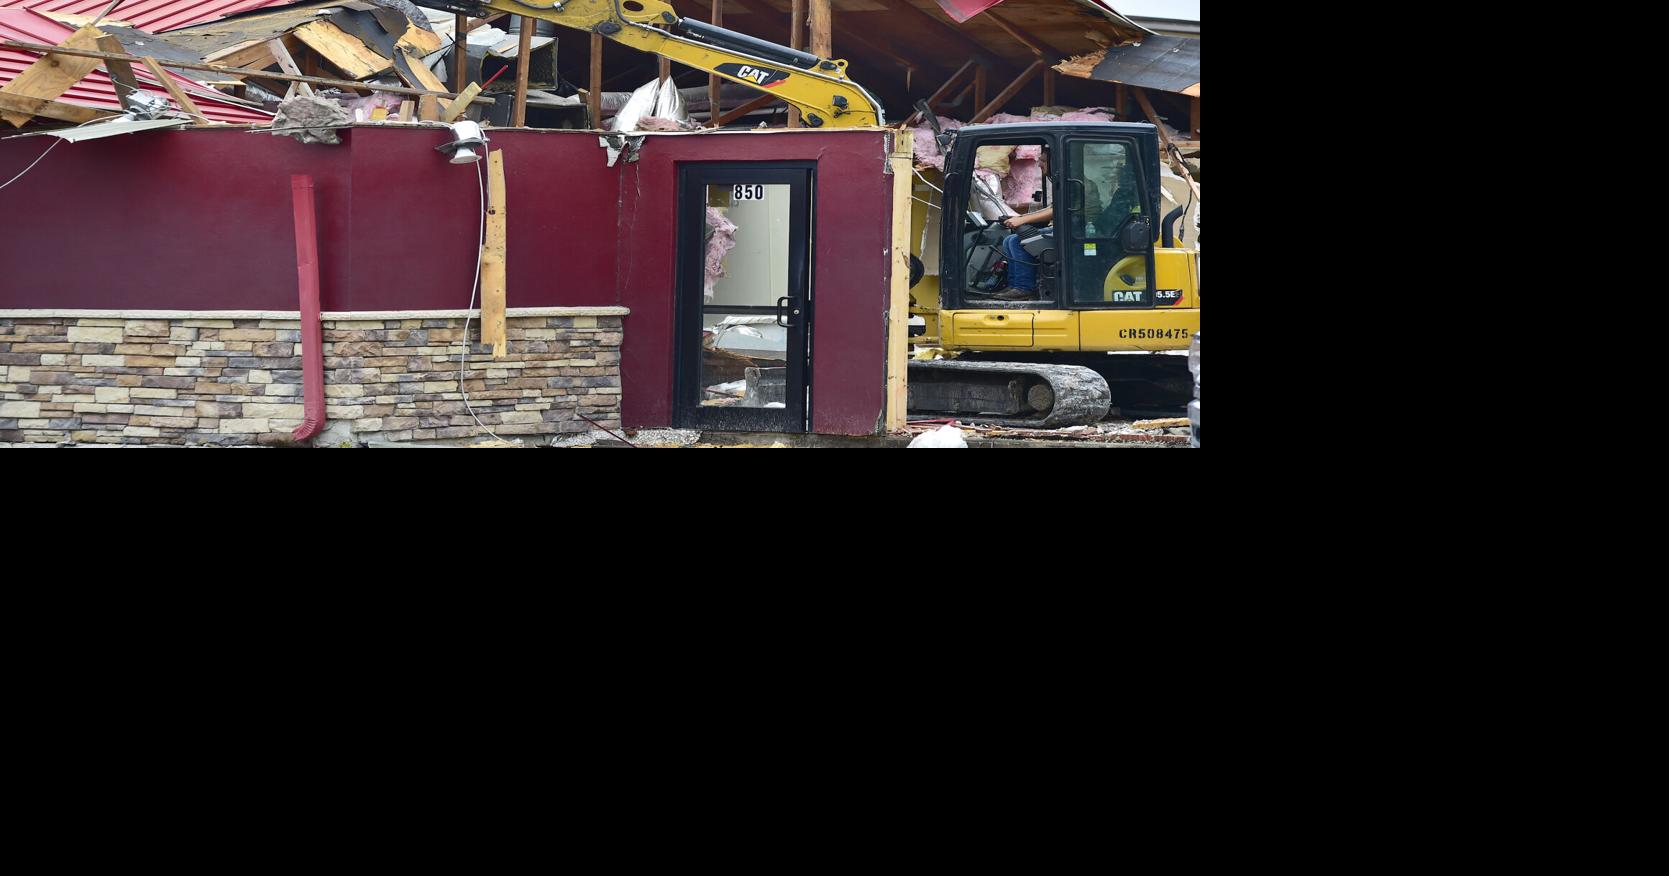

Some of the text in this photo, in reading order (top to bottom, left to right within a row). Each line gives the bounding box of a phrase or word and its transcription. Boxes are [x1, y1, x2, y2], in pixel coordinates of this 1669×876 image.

[737, 65, 769, 85] CAT
[734, 184, 764, 200] 850
[1113, 291, 1143, 302] CAT
